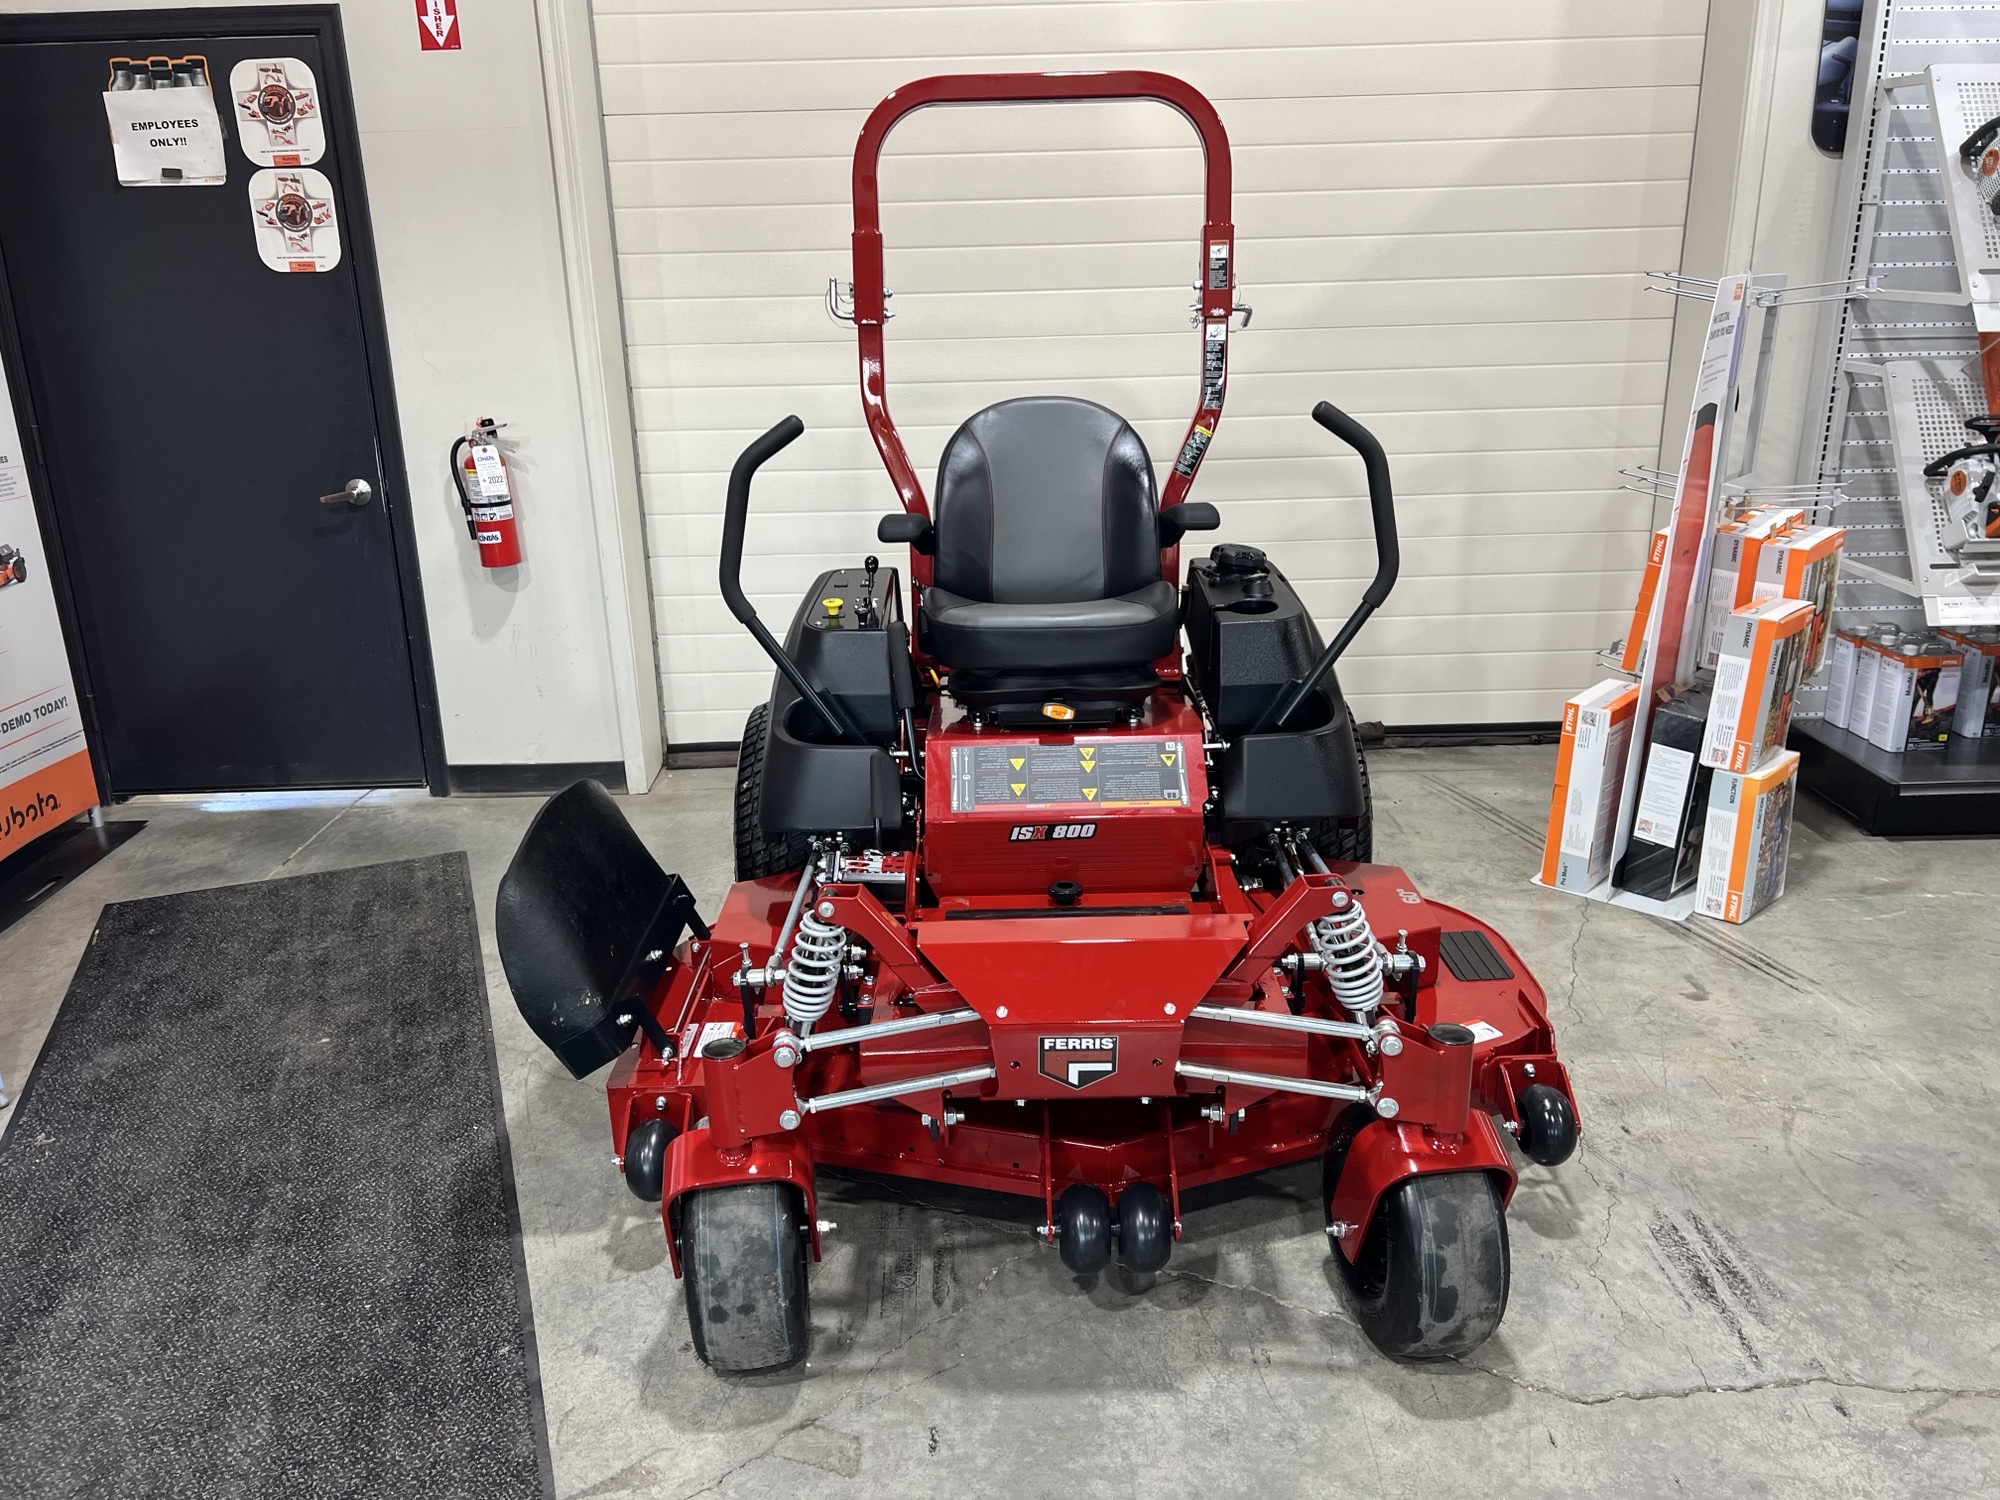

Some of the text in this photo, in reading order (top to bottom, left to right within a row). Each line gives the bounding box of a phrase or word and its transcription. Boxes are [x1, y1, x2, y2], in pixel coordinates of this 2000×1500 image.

[131, 119, 199, 131] EMPLOYEES
[149, 137, 187, 147] ONLY!!
[488, 475, 504, 485] 2022
[1653, 537, 1665, 563] STIHL
[1731, 539, 1740, 563] DYNAMIC
[1776, 550, 1785, 575] DYNAMIC
[1743, 622, 1753, 648] DYNAMIC
[33, 696, 69, 720] TODAY!
[1565, 706, 1575, 733] STIHL
[1734, 744, 1747, 772] STIHL
[1729, 778, 1738, 804] FUNCTION
[0, 792, 59, 839] ubota
[1010, 824, 1096, 840] ISX 800
[1728, 894, 1739, 921] STIHL
[1044, 1038, 1114, 1050] FERRIS
